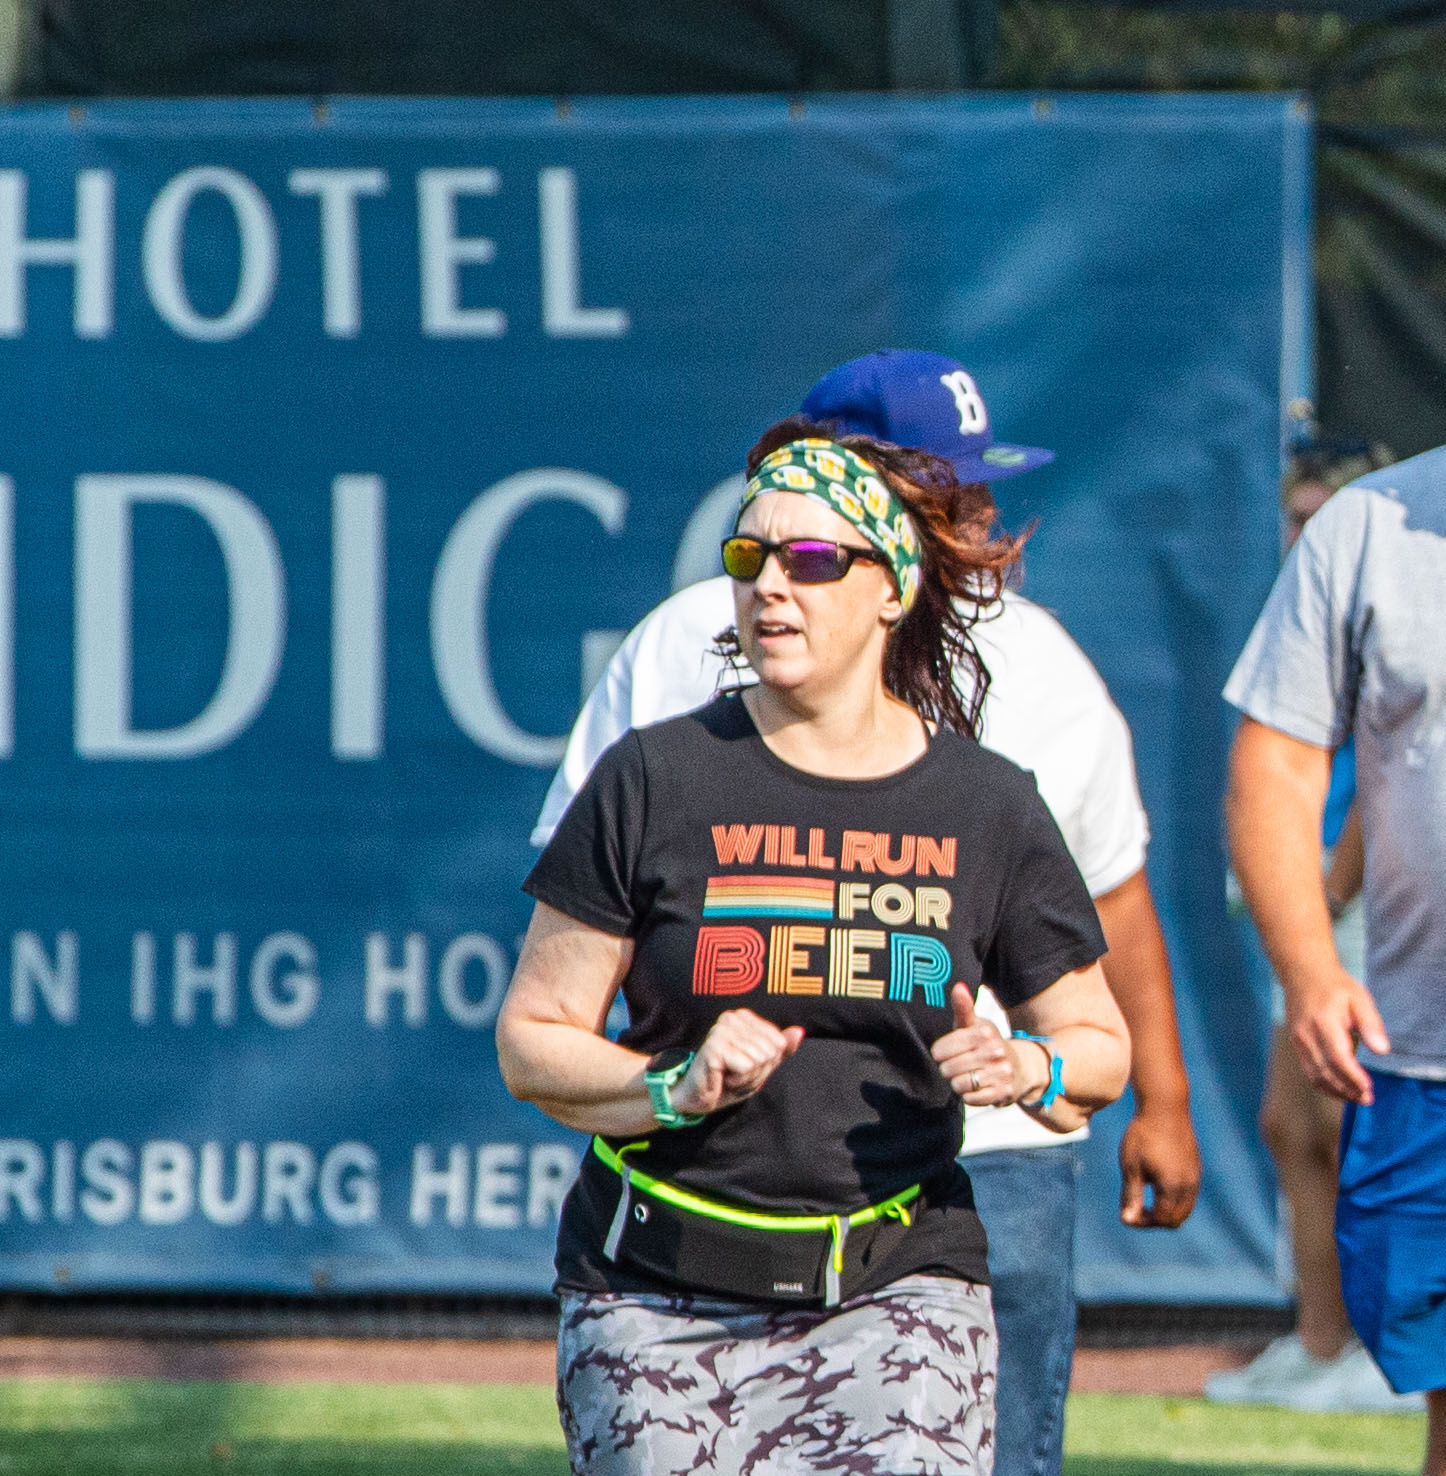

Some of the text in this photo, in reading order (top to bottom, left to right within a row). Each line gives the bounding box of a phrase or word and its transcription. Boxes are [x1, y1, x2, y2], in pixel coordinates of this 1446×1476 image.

[0, 166, 630, 342] HOTEL
[939, 369, 988, 435] B
[0, 467, 748, 768] DIG
[711, 824, 957, 878] WILL RUN
[838, 881, 952, 930] FOR
[10, 929, 528, 1029] N IHG HO
[692, 924, 952, 1008] BEER
[0, 1138, 583, 1229] RISBURG HER
